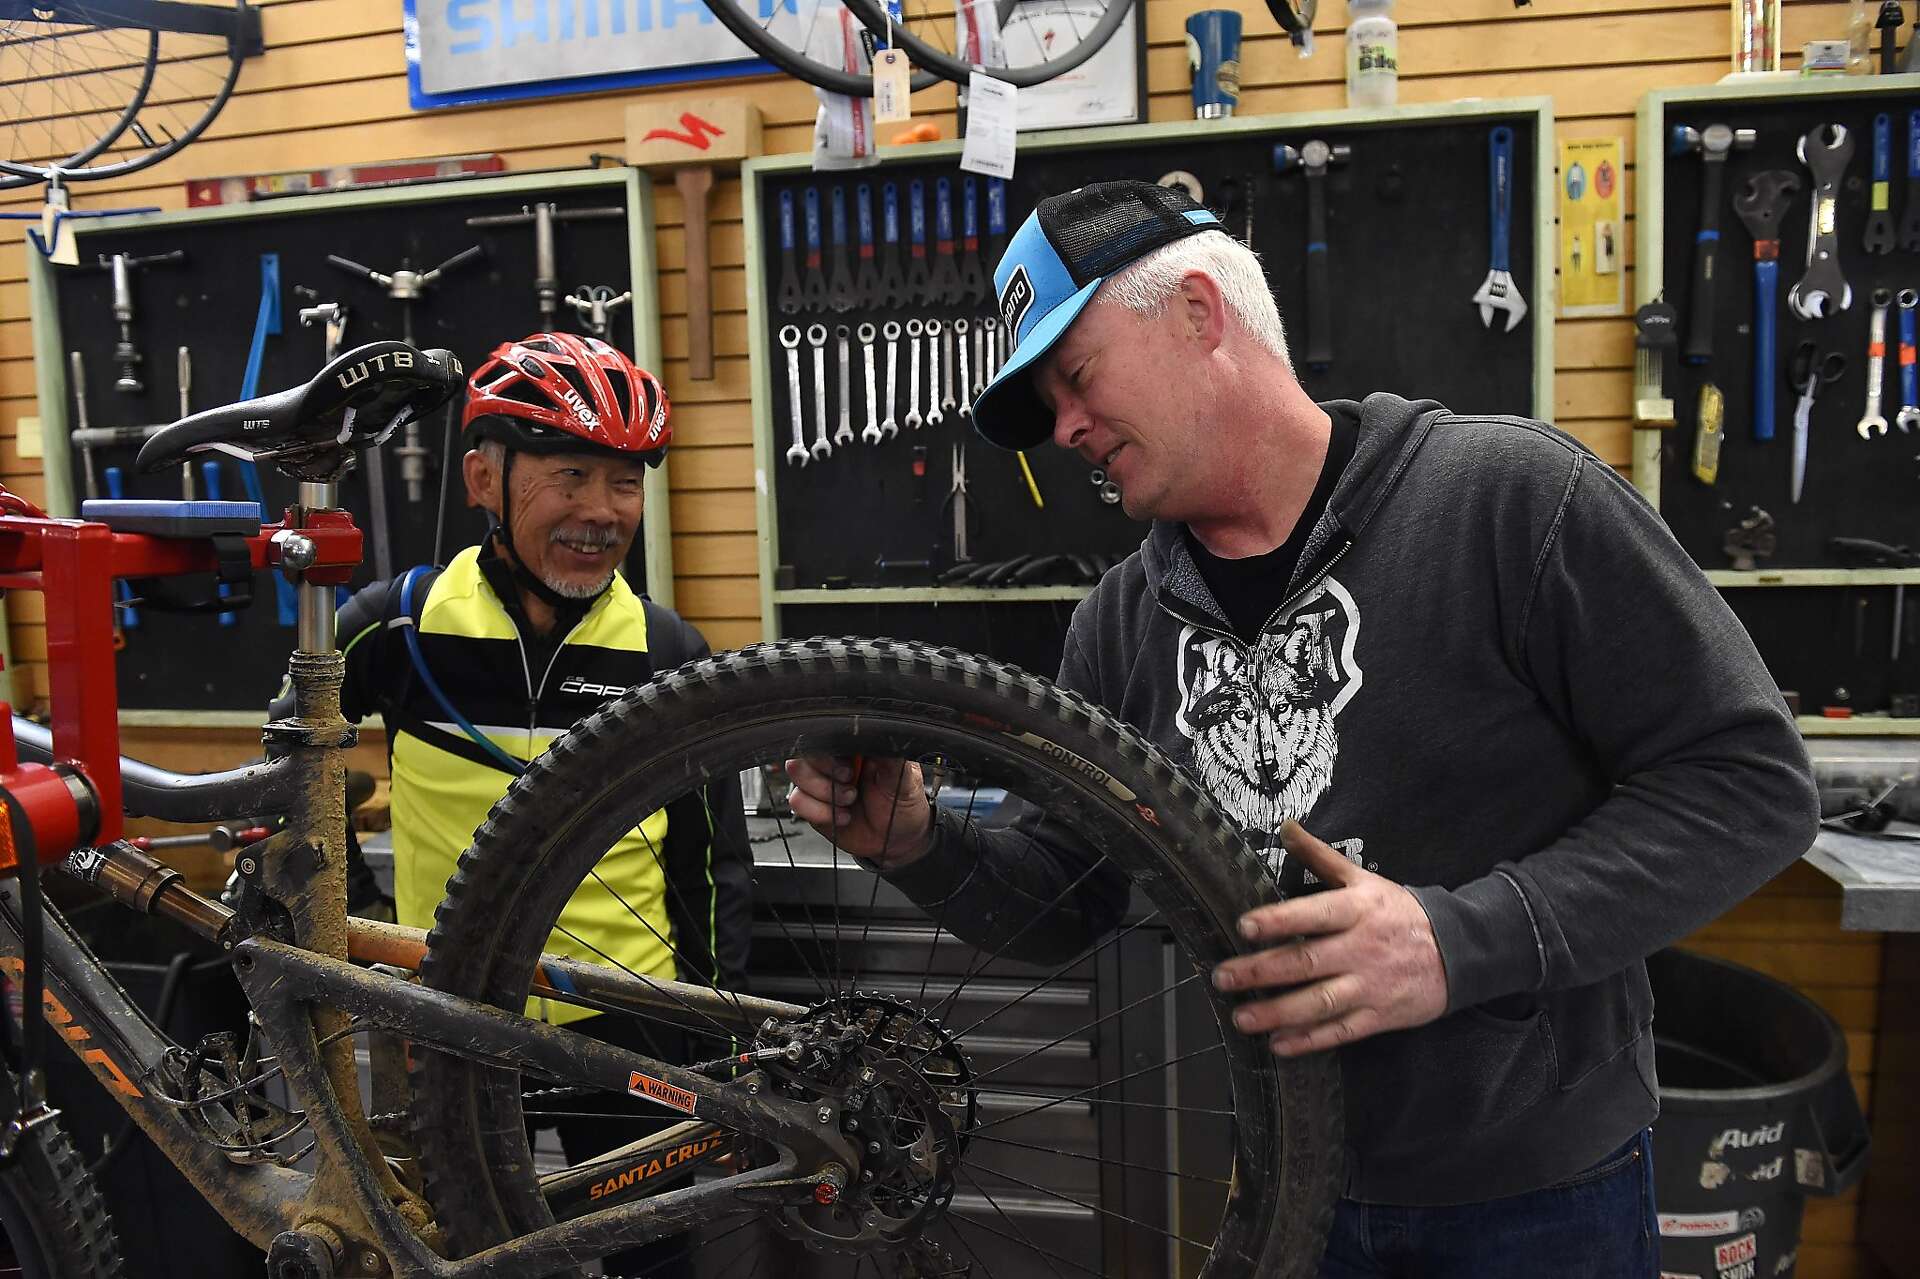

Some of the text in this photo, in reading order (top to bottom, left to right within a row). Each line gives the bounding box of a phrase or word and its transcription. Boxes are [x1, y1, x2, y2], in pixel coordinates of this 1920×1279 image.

[337, 351, 414, 389] WTB
[563, 388, 601, 432] uvex
[1040, 740, 1112, 791] CONTROL
[648, 1080, 692, 1108] WARNING
[1718, 1120, 1786, 1149] Avid
[590, 1129, 721, 1201] SANTA CRUZ
[1718, 1237, 1756, 1266] ROCK
